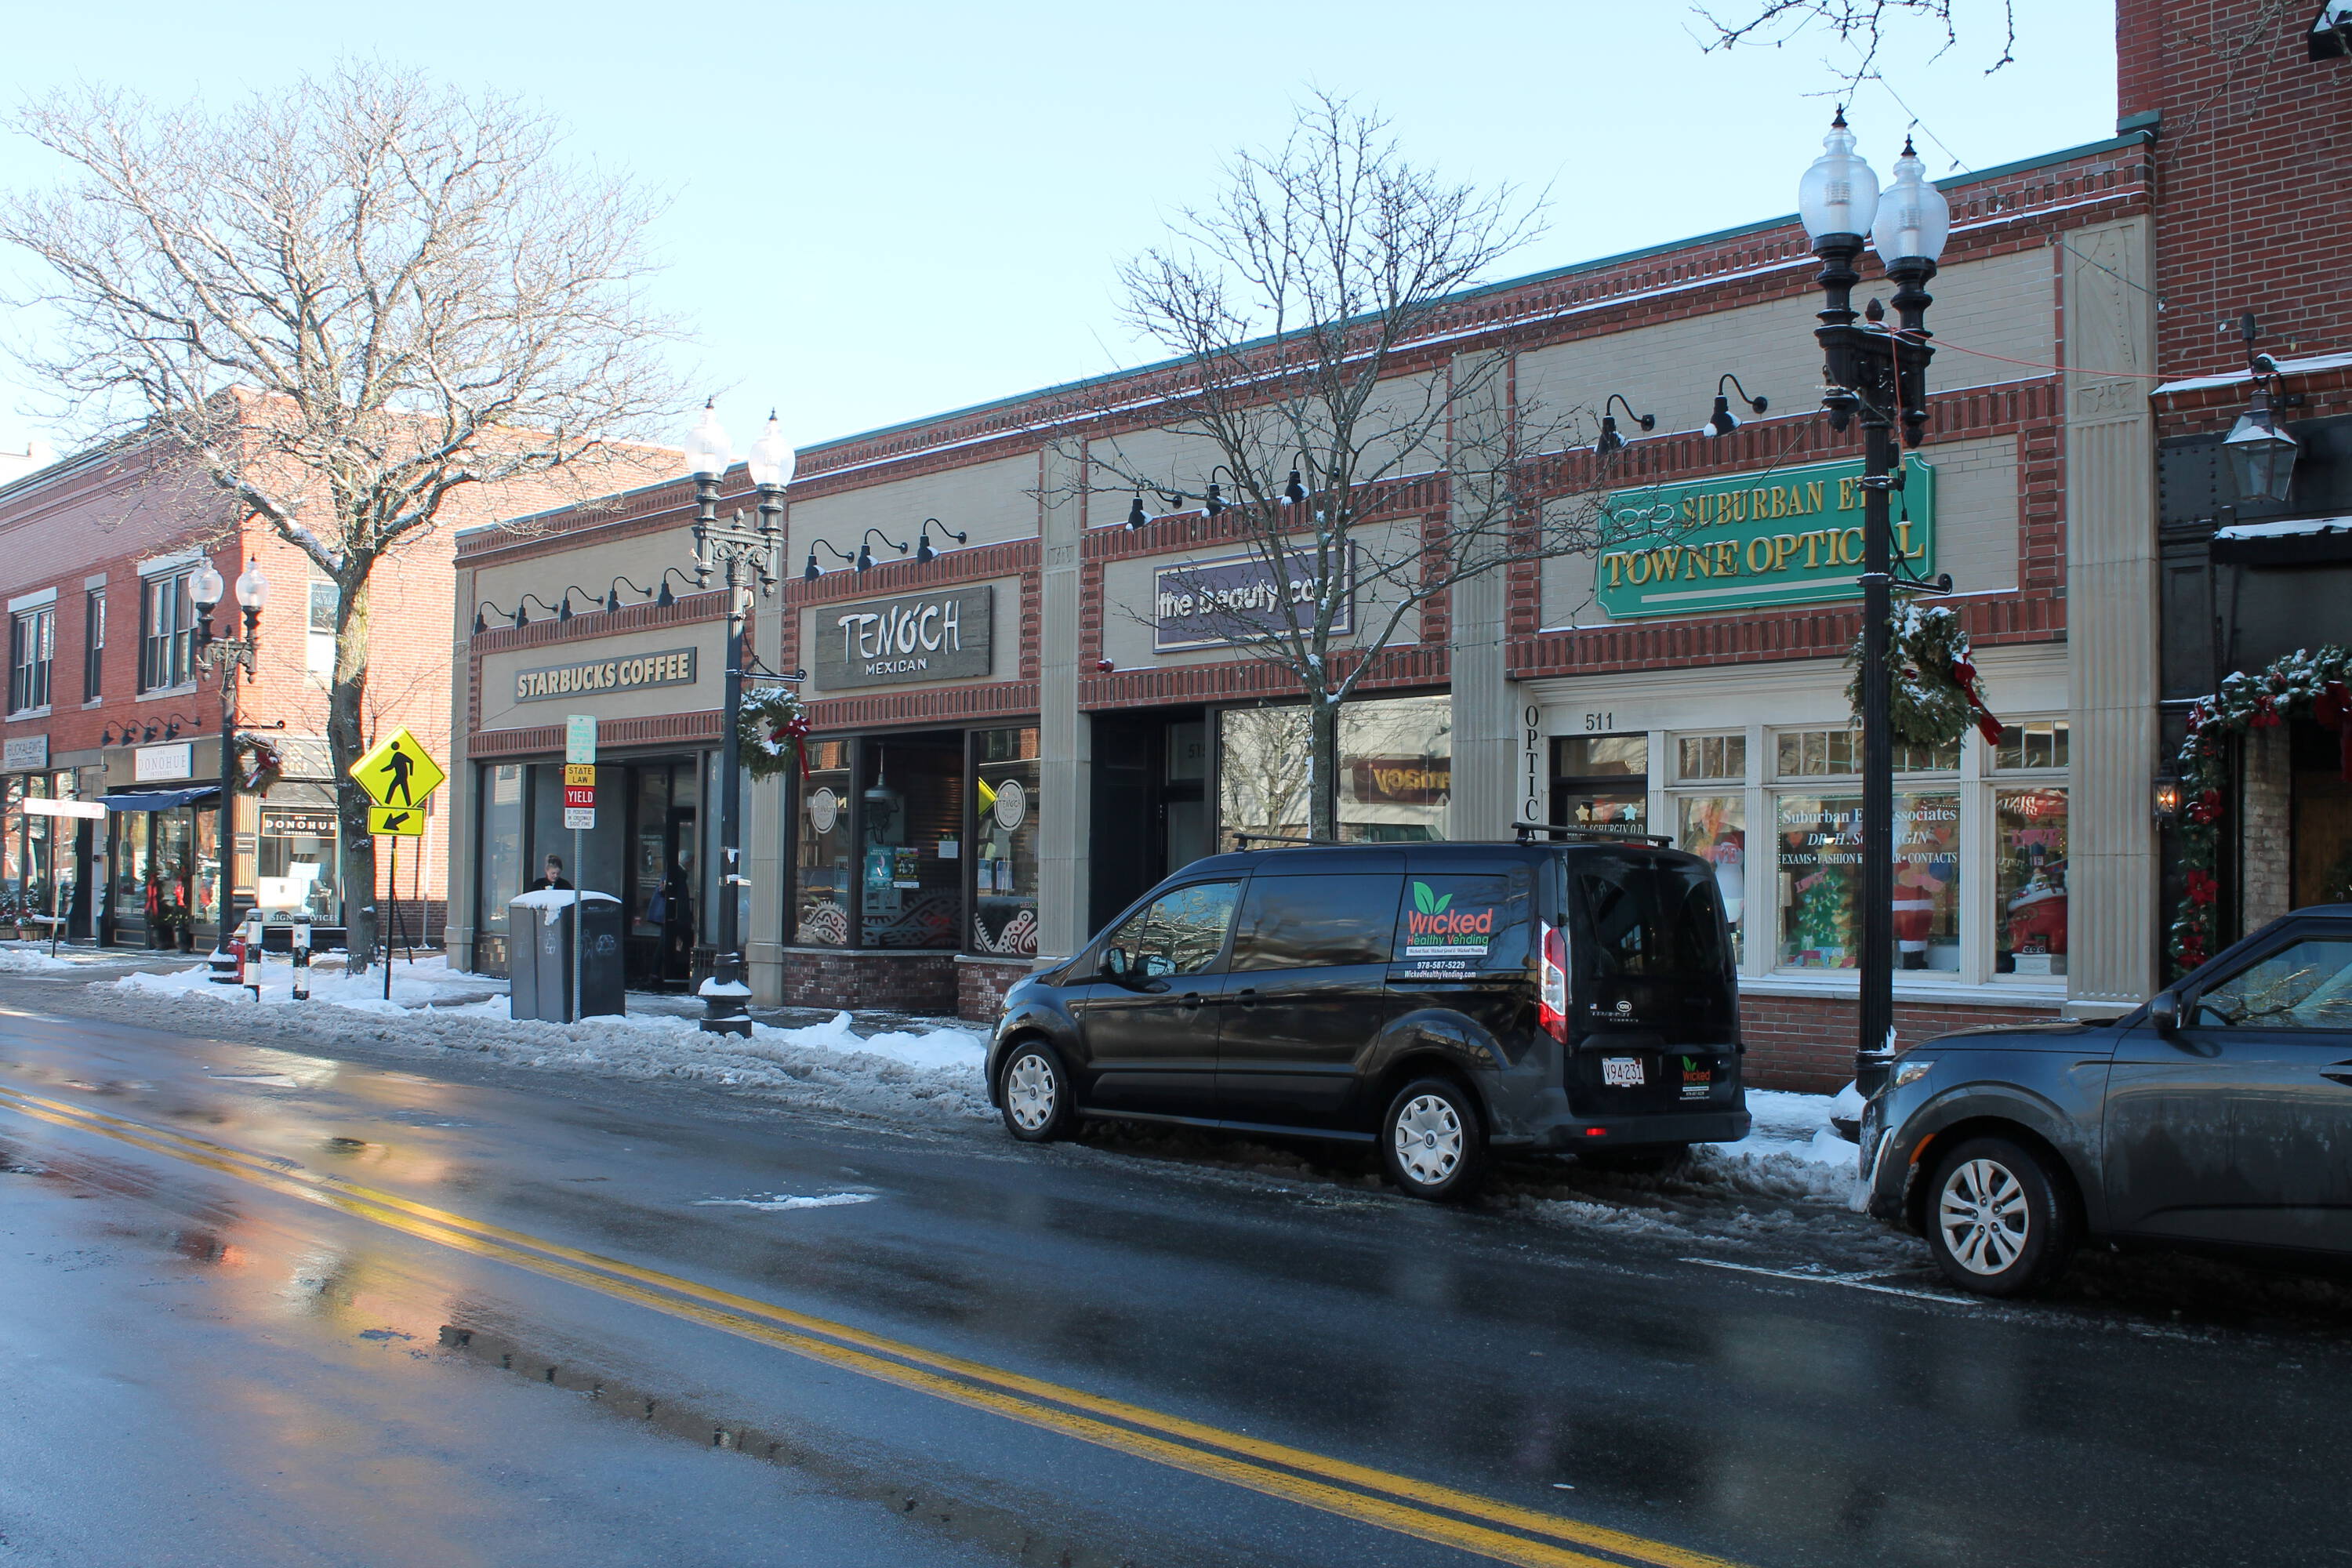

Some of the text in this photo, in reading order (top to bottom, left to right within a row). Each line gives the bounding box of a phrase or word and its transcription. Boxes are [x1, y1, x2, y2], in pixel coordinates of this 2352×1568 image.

[1682, 480, 1824, 528] SUBURBAN
[1602, 520, 1925, 588] TOWNE OPTICL
[1160, 590, 1193, 619] the
[517, 653, 690, 698] STARBUCKS COFFEE
[866, 658, 927, 676] MEXICAN
[1585, 713, 1613, 731] 511
[138, 755, 187, 771] DONOHUE
[568, 790, 593, 803] YIELD
[1782, 809, 1849, 824] Suburban
[1893, 807, 1957, 822] ssociates
[265, 820, 336, 829] DONOHUE
[1907, 852, 1958, 863] CONTACTS
[1408, 908, 1494, 934] Wicked
[1407, 934, 1489, 947] Healthy Vending
[1404, 970, 1476, 979] WickedHealthyVending.com
